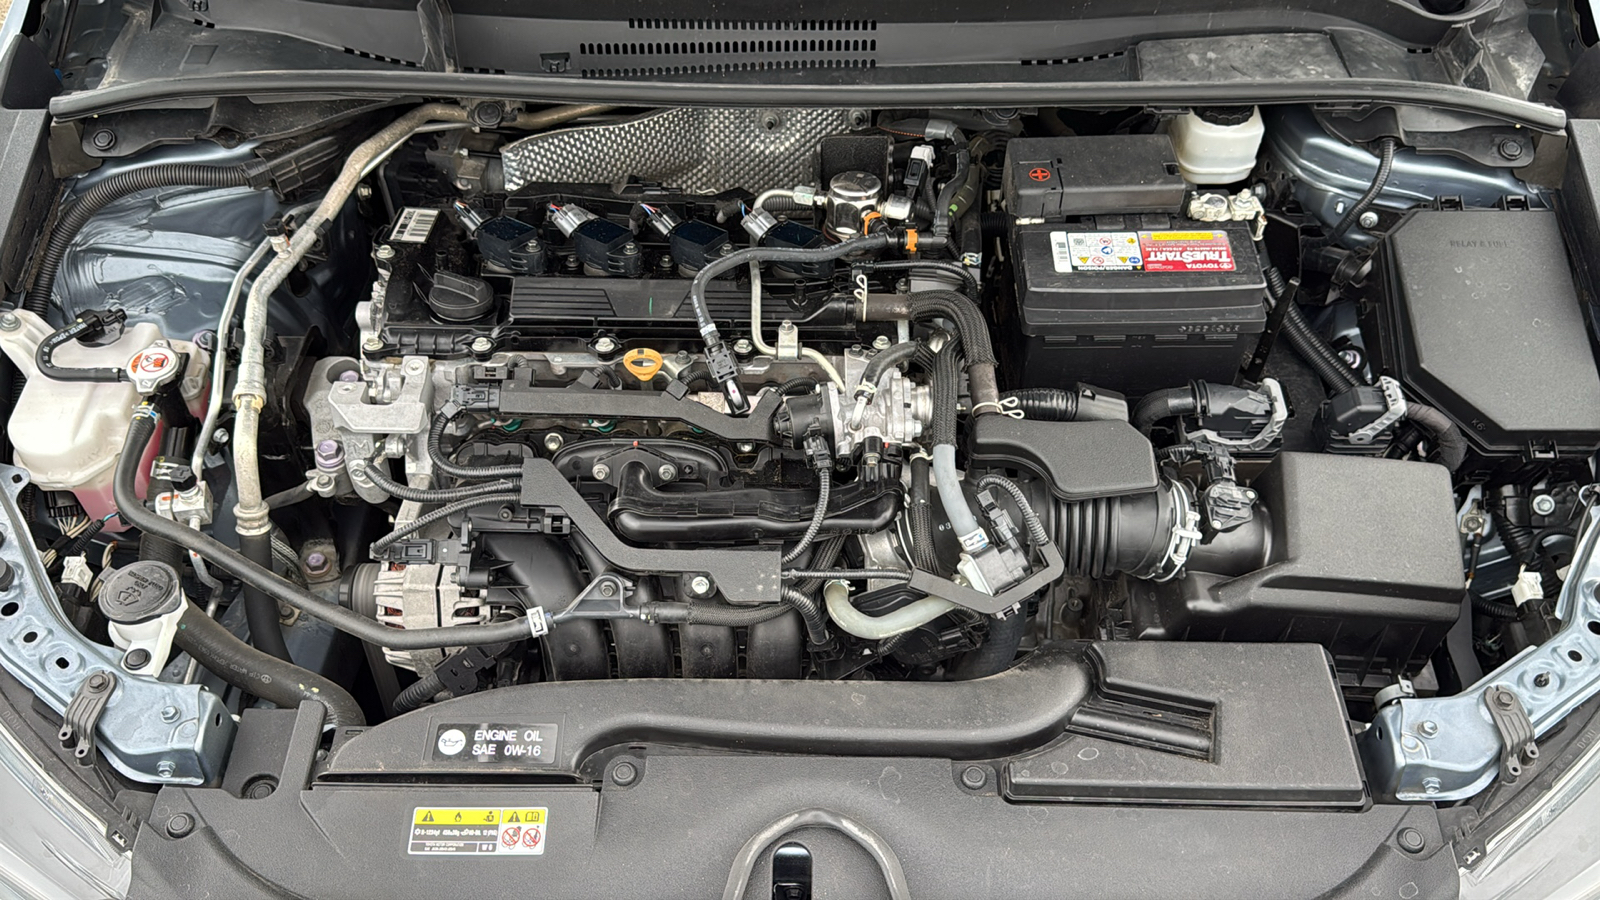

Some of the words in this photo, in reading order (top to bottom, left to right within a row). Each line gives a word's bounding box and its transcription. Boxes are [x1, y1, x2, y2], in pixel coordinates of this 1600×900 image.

[1449, 239, 1477, 248] RELAY
[474, 729, 518, 742] ENGINE
[523, 730, 543, 742] OIL
[472, 743, 497, 756] SAE
[503, 745, 542, 757] 0W-16
